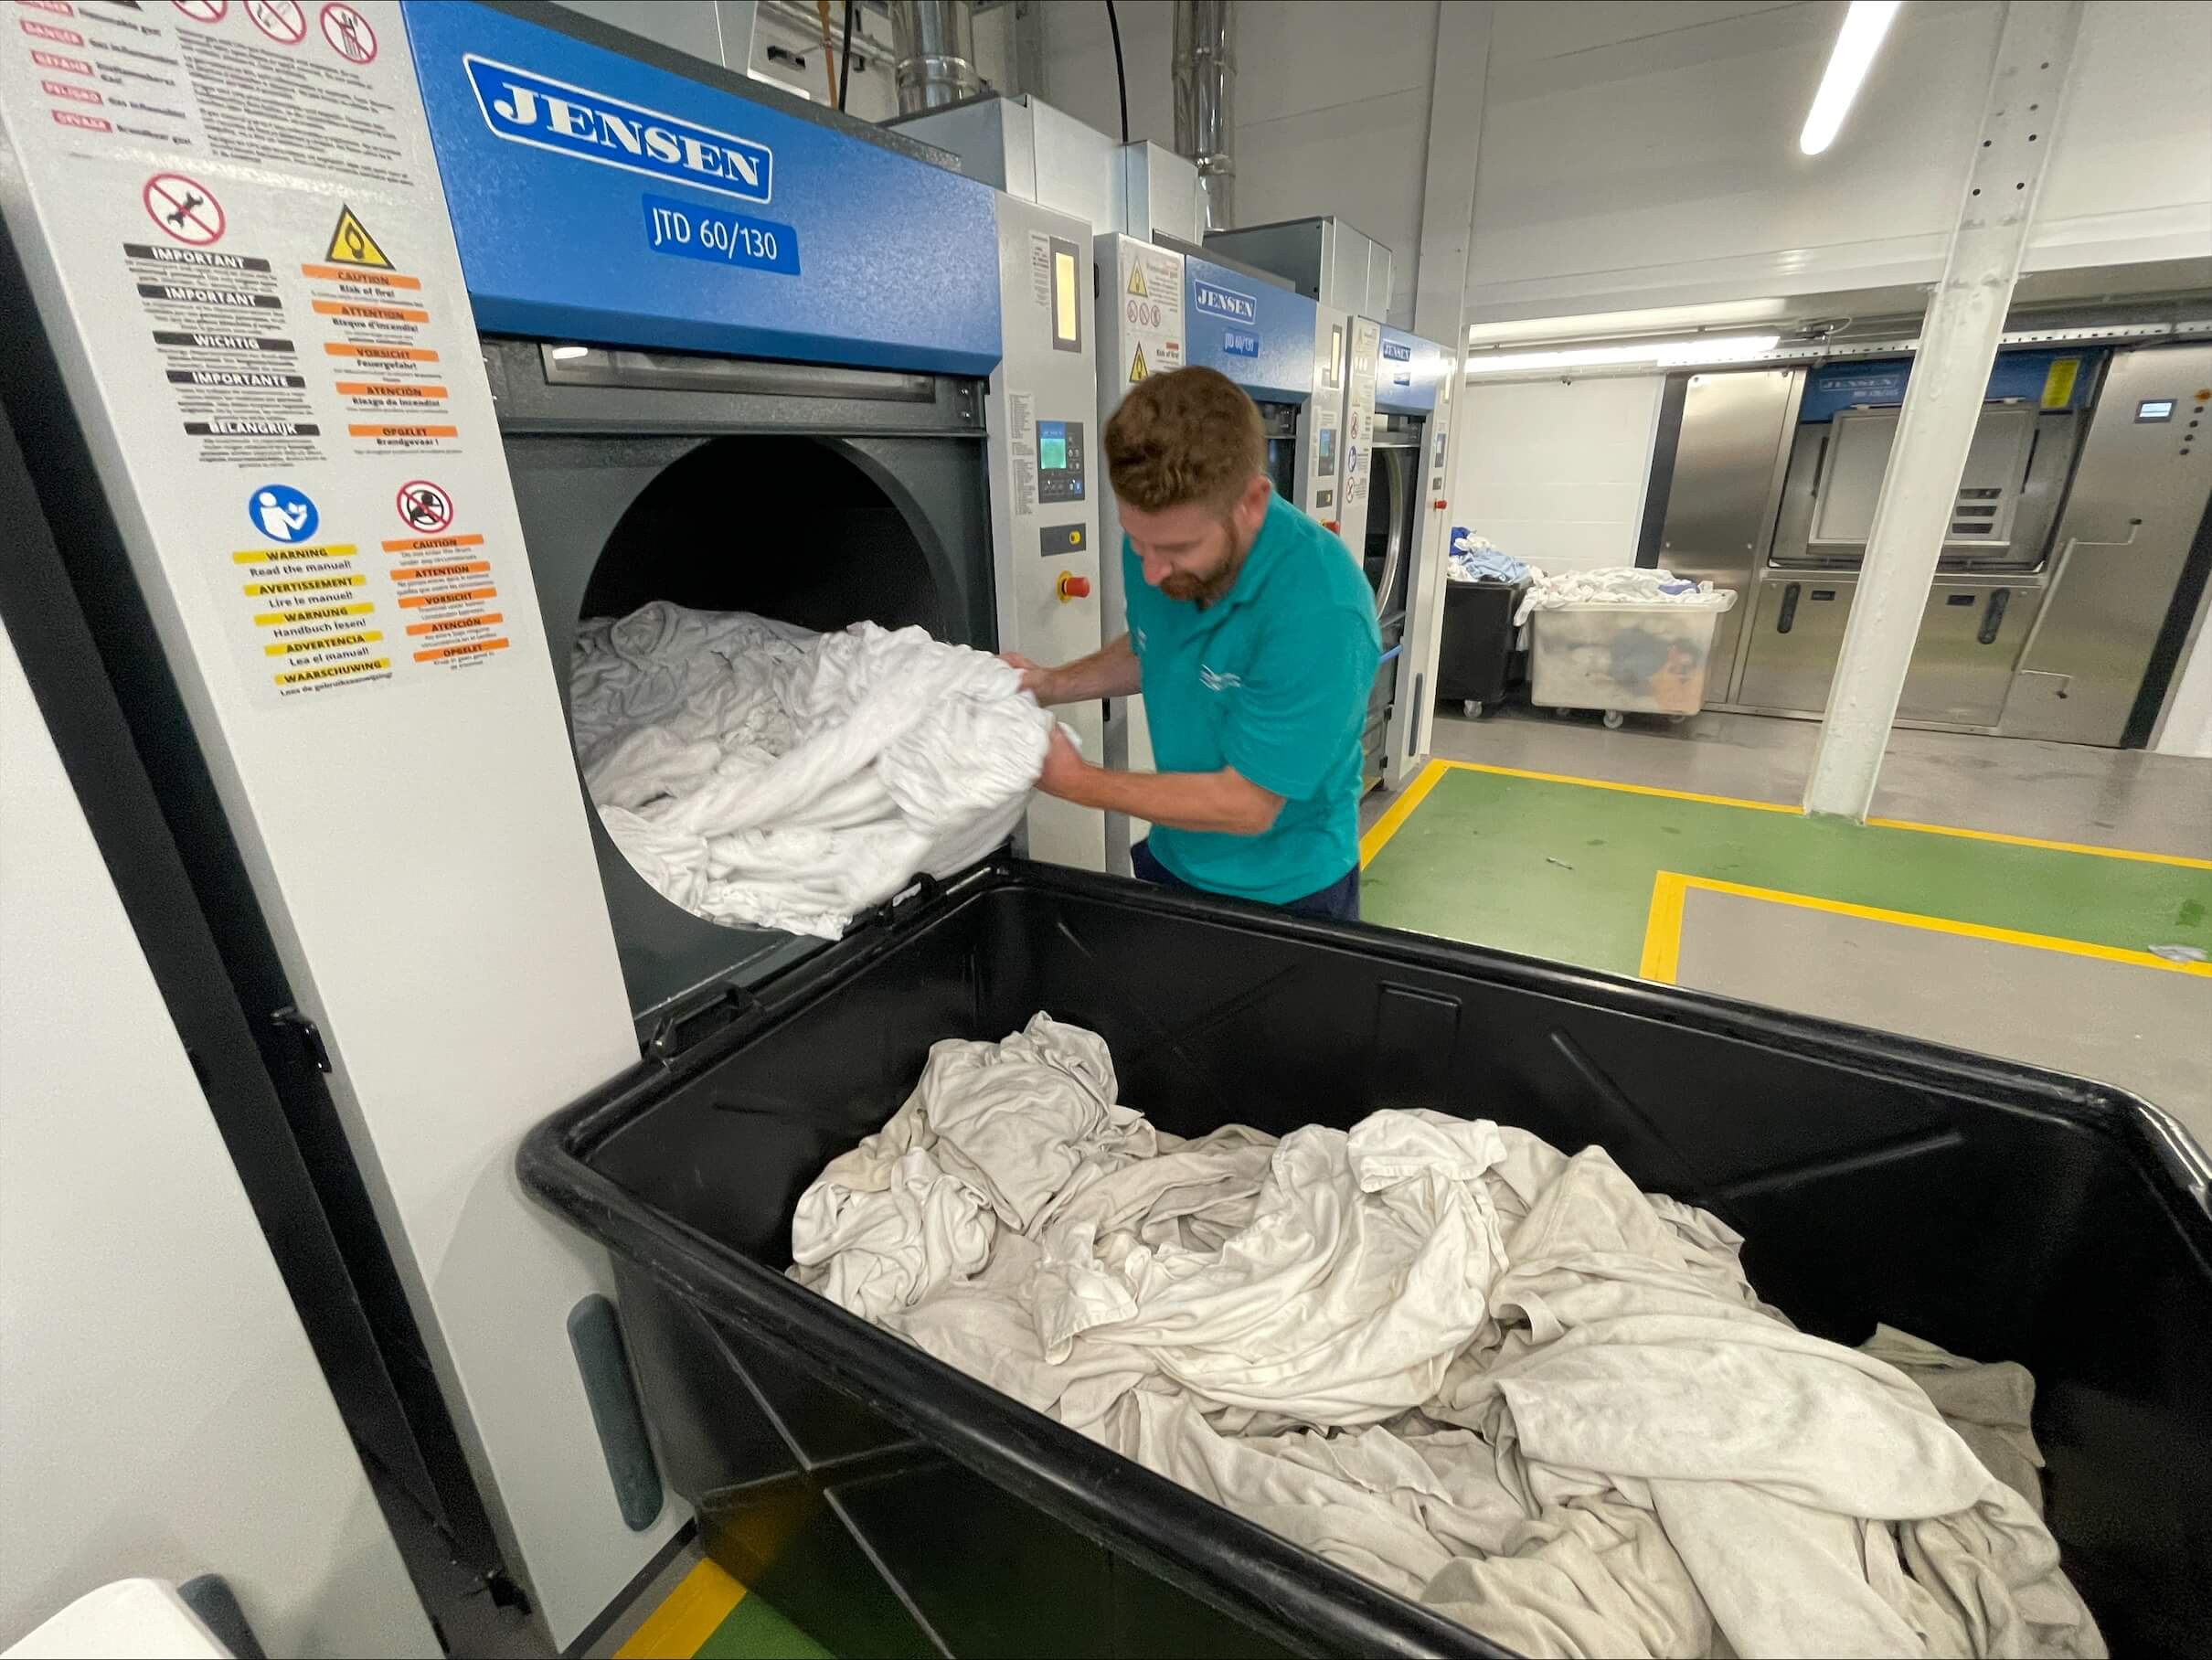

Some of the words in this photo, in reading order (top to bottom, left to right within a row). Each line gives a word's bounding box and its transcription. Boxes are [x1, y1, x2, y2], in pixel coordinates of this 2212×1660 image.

[494, 82, 760, 187] JENSEN
[652, 208, 691, 247] JTD
[699, 218, 777, 261] 60/130
[151, 247, 244, 269] IMPORTANT
[337, 271, 390, 286] CAUTION
[164, 286, 256, 306] IMPORTANT
[339, 284, 360, 293] Risk
[363, 286, 373, 295] of
[1197, 288, 1254, 318] JENSEN
[341, 305, 404, 321] ATTENTION
[193, 334, 261, 350] WICHTIG
[356, 348, 410, 360] VORSICHT
[1384, 344, 1410, 360] JENSEN
[192, 371, 290, 388] IMPORTANTE
[208, 421, 299, 437] BELANGRIJK
[412, 538, 457, 549] CAUTION
[265, 548, 329, 561] WARNING
[250, 566, 281, 578] Read
[283, 564, 303, 575] the
[305, 560, 351, 572] manual!
[415, 565, 470, 578] ATTENTION
[259, 578, 353, 595] AVERTISSEMENT
[269, 597, 292, 609] Lire
[294, 595, 306, 606] le
[308, 591, 353, 603] manuel!
[424, 592, 473, 605] VORSICHT
[283, 607, 349, 622] WARNUNG
[272, 623, 333, 638] Handbuch
[334, 618, 367, 630] lesen!
[286, 634, 366, 654] ADVERTENCIA
[443, 644, 483, 657] OPGELET
[289, 656, 311, 667] Lea
[313, 654, 324, 664] el
[325, 647, 369, 660] manual!
[283, 660, 382, 684] WAARSCHUWING
